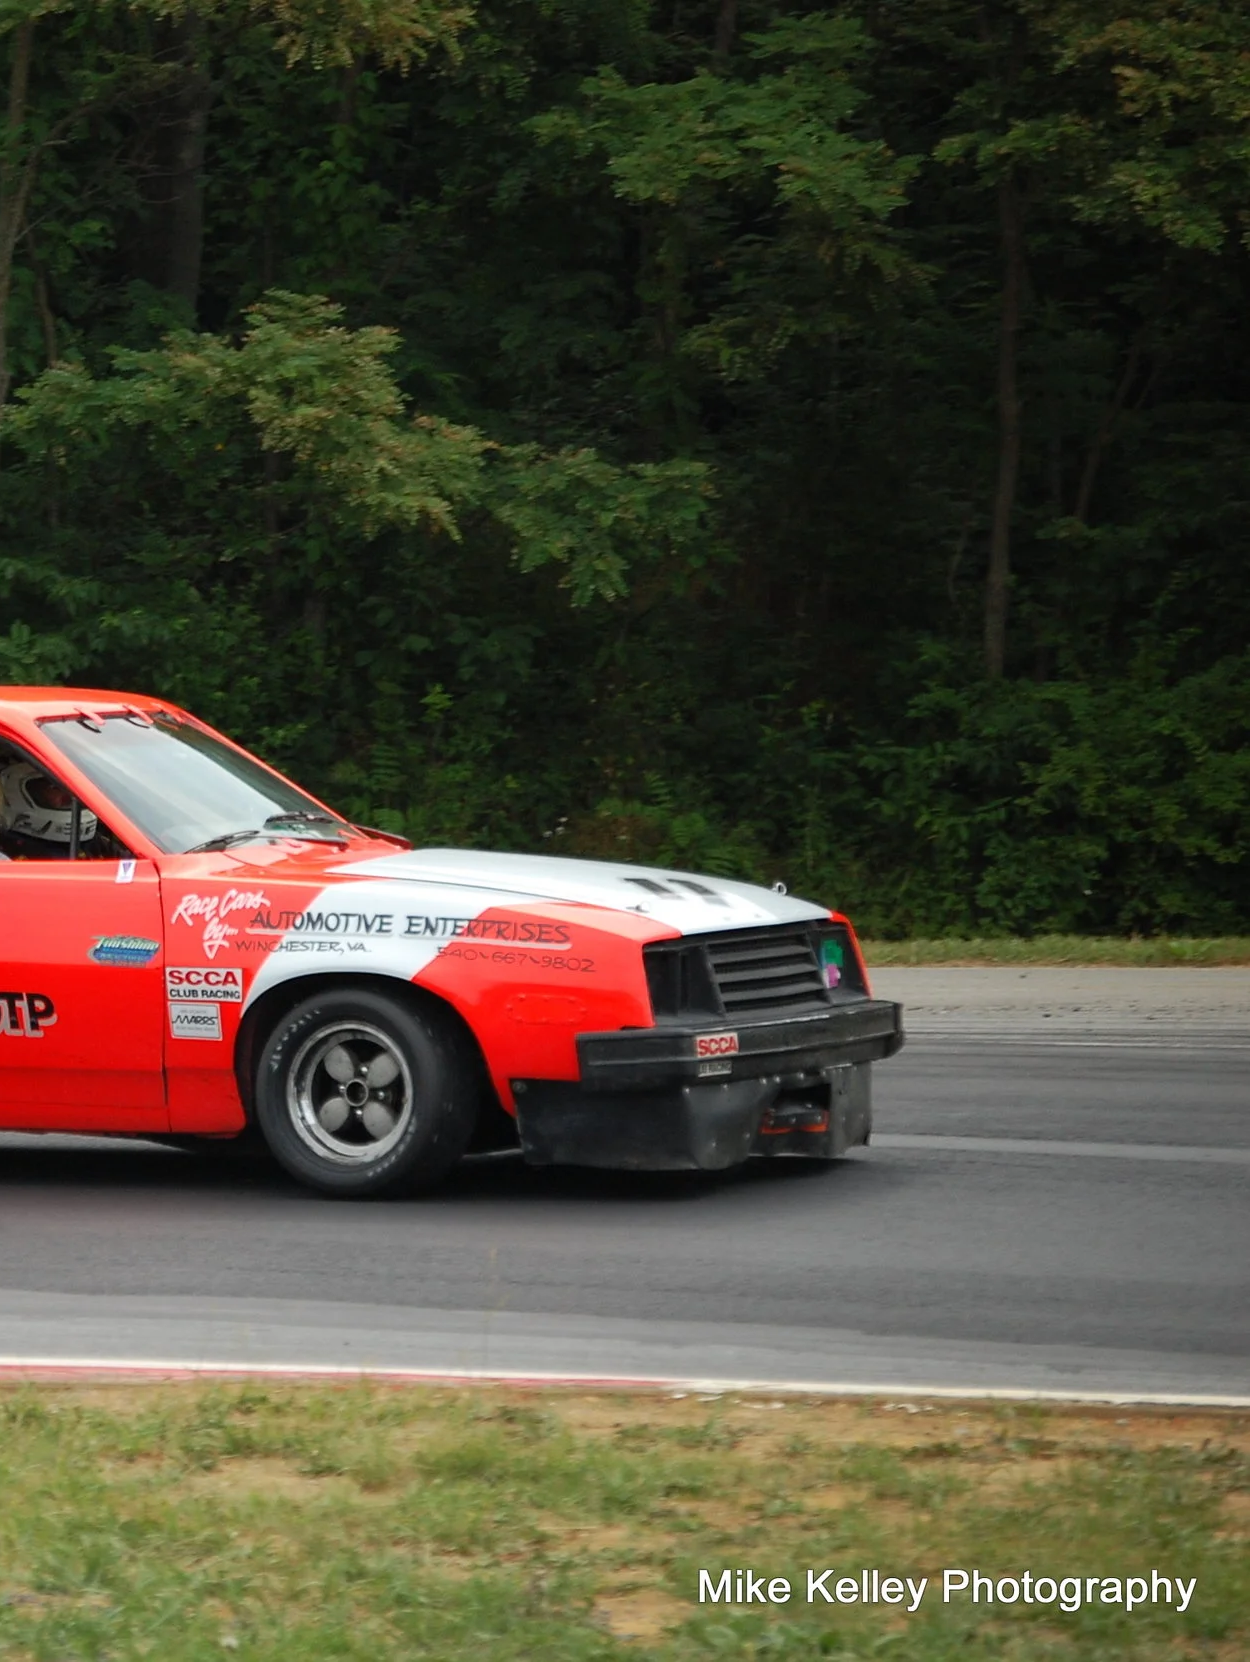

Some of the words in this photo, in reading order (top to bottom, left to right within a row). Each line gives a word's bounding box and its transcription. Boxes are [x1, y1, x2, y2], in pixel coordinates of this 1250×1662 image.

[171, 894, 225, 926] Race
[220, 889, 272, 917] Cars
[250, 911, 392, 934] AUTOMOTIVE
[404, 915, 570, 943] ENTERPRISES
[235, 940, 346, 955] WINCHESTER,
[168, 970, 239, 987] SCCA
[169, 989, 198, 999] CLUB
[201, 989, 240, 1000] RACING
[698, 1036, 738, 1057] SCCA
